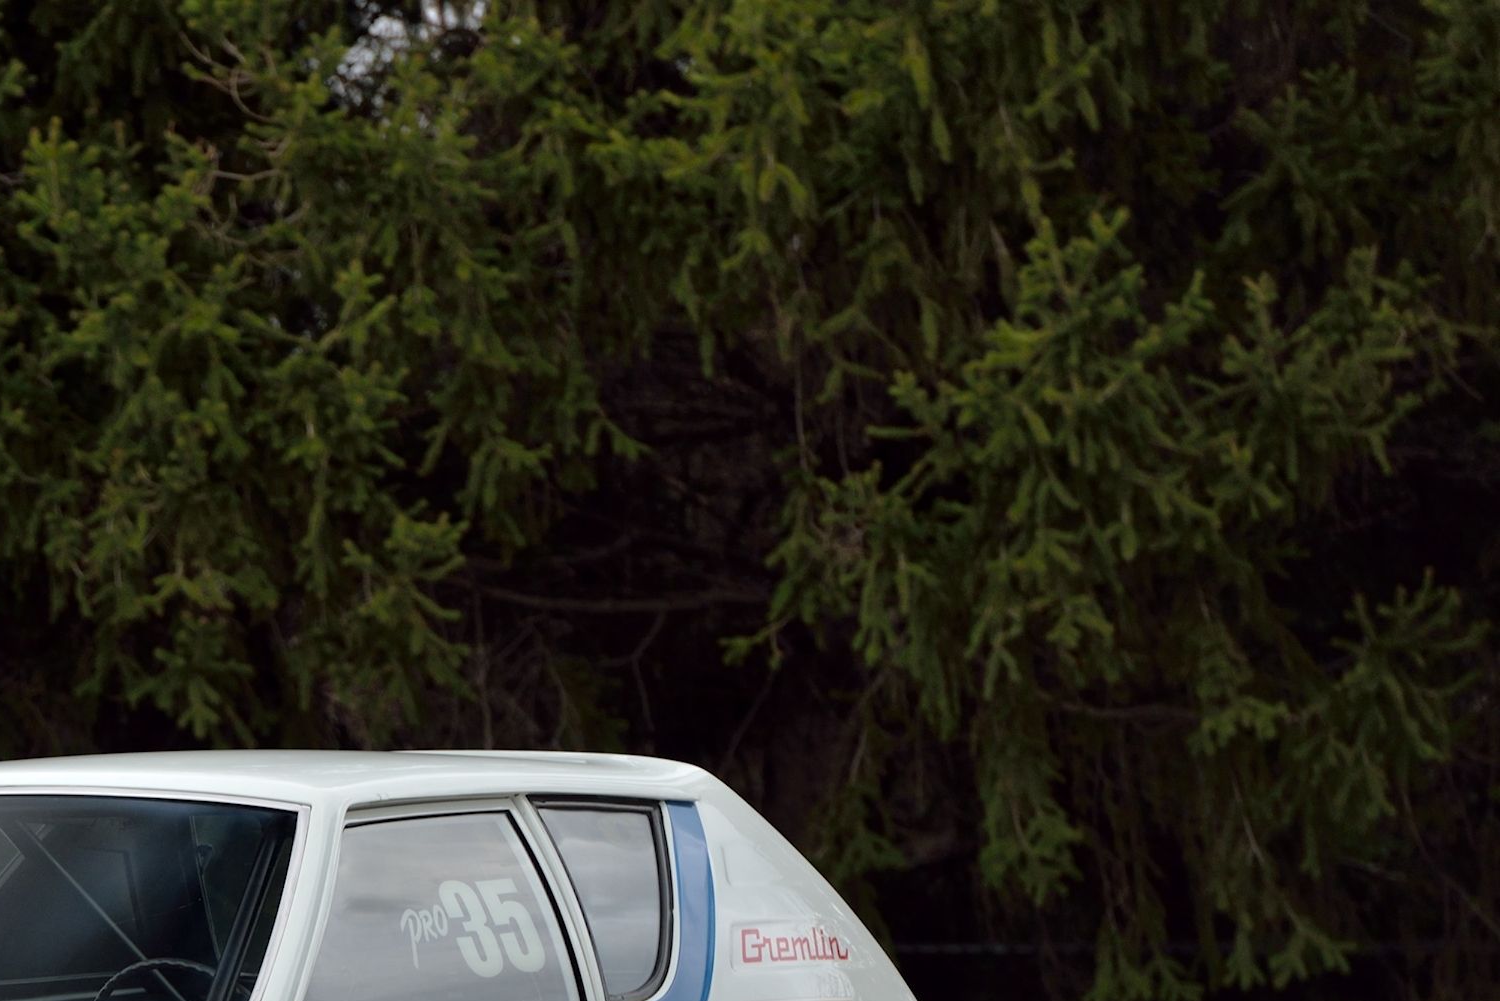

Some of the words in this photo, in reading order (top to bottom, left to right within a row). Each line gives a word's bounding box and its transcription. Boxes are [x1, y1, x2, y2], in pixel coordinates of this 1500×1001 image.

[401, 904, 449, 969] PRO
[438, 878, 546, 978] 35
[741, 927, 849, 963] Gremlin
